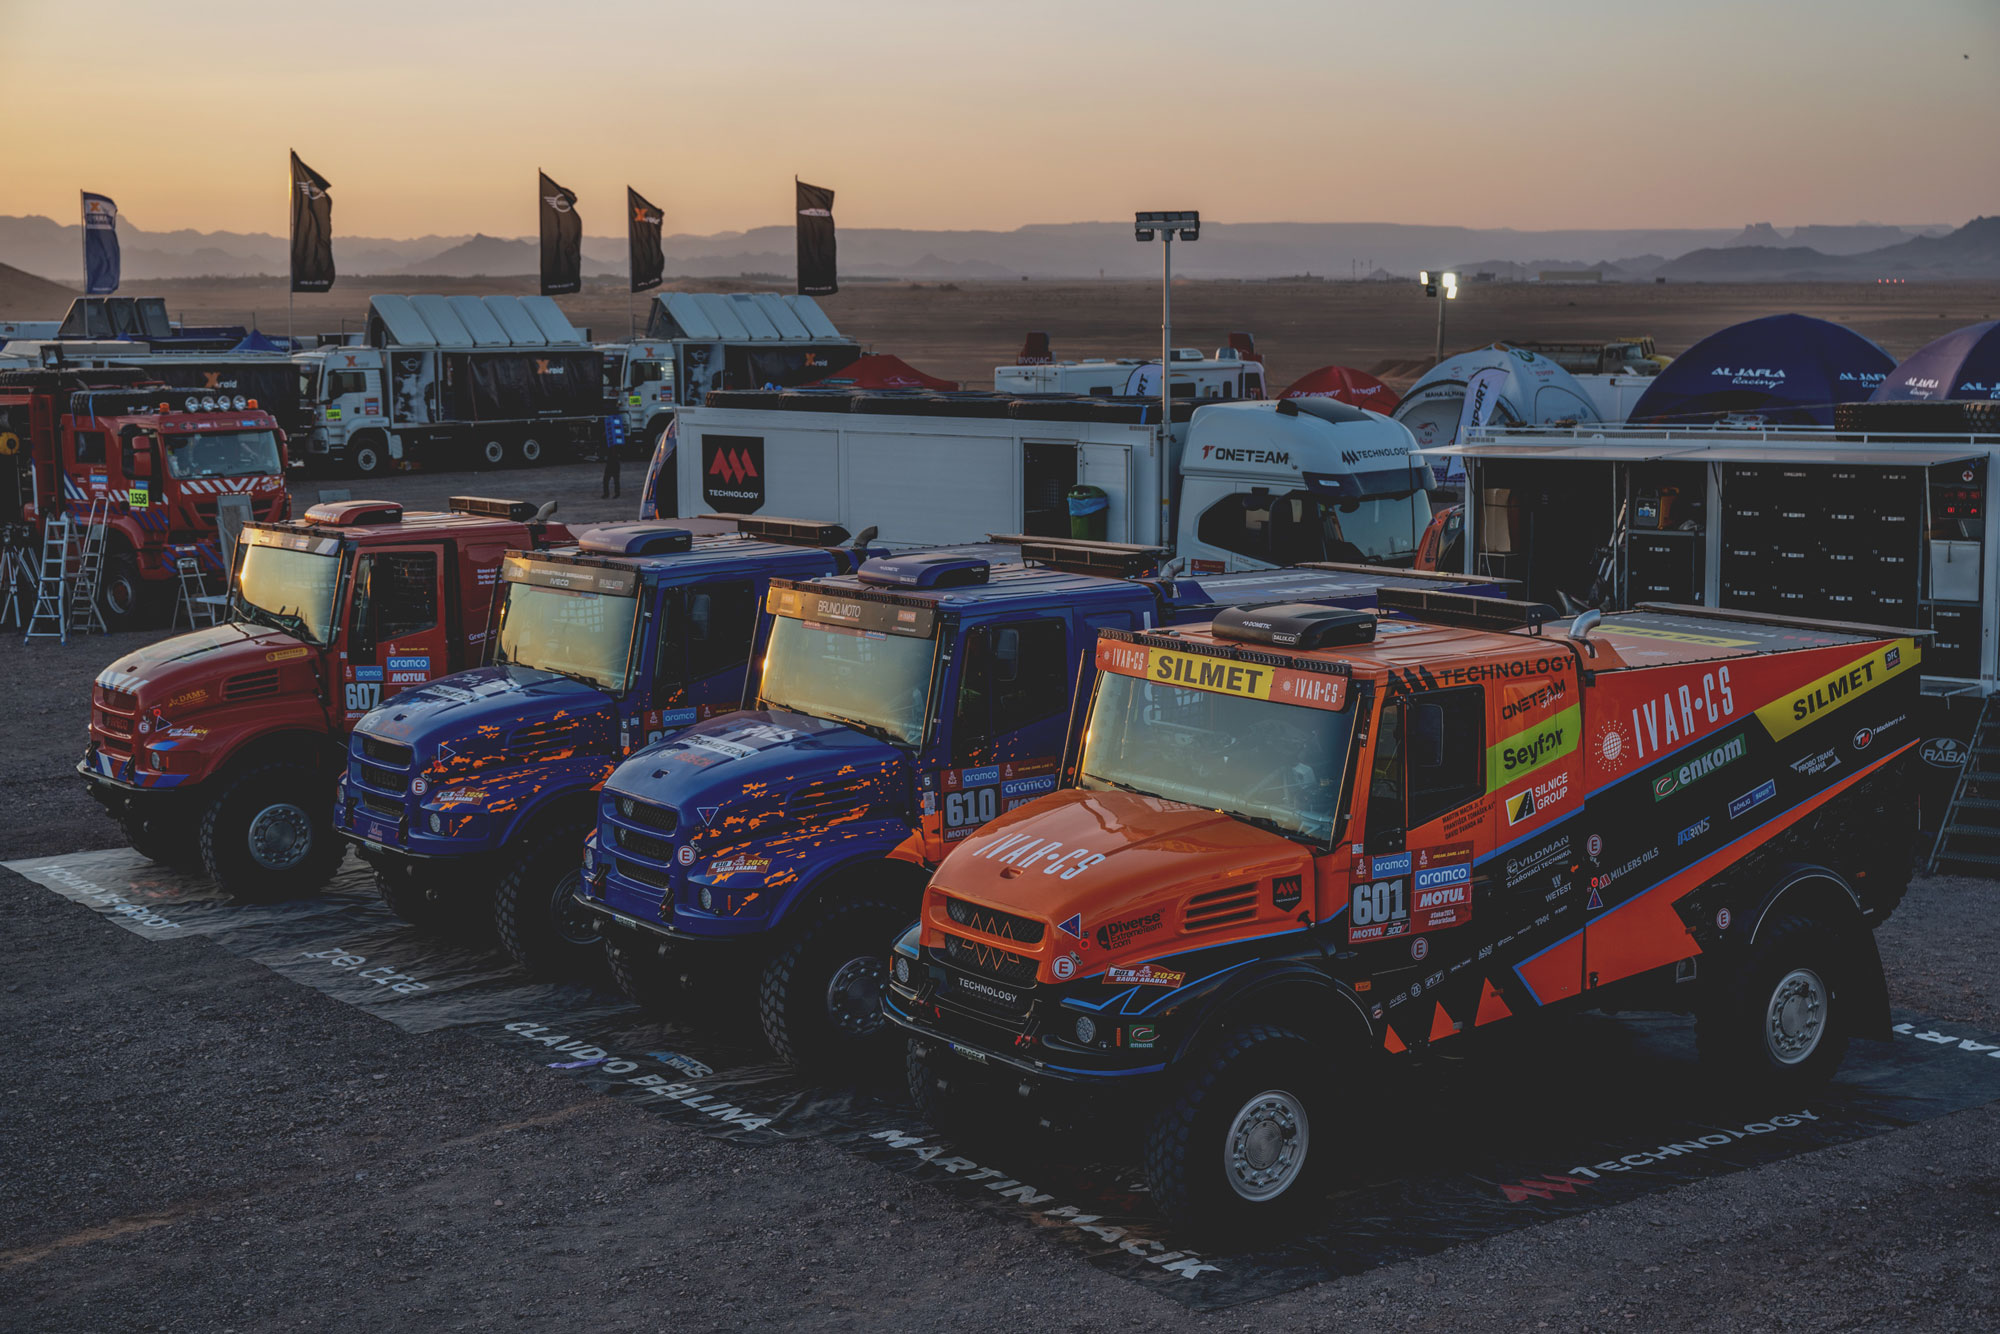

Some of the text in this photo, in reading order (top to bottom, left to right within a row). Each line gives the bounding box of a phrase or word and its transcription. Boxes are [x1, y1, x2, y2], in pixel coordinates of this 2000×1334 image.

[1711, 367, 1732, 376] AL
[1215, 448, 1289, 465] ONETEAM
[1357, 446, 1409, 459] TECHNOLOGY
[709, 489, 758, 499] TECHNOLOGY
[818, 600, 861, 616] BRUNO MOTO
[1248, 621, 1272, 630] DOMETIC
[390, 658, 427, 668] aramco
[1886, 648, 1899, 662] DFC
[357, 669, 382, 677] aramco
[391, 673, 427, 682] MOTUL
[1156, 655, 1263, 694] SILMET
[1440, 655, 1576, 686] TECHNOLOGY
[345, 683, 381, 711] 607
[1502, 680, 1566, 720] ONETEAM
[1793, 660, 1875, 721] SILMET
[664, 712, 695, 722] aramco
[1679, 737, 1743, 785] enkom
[1798, 748, 1836, 773] PROBO TRANS
[1808, 761, 1828, 775] PRAHA
[965, 771, 998, 782] aramco
[1005, 778, 1051, 794] aramco
[1535, 772, 1568, 797] SILNICE
[946, 788, 996, 827] 610
[1537, 786, 1568, 810] GROUP
[1519, 835, 1569, 867] VILDMAN
[1541, 850, 1572, 869] TECHNIKA
[746, 858, 768, 866] 2024
[1374, 860, 1409, 872] aramco
[1610, 847, 1660, 882] MILLERS OILS
[1419, 868, 1467, 886] aramco
[1353, 879, 1407, 926] 601
[1419, 887, 1464, 908] MOTUL
[1545, 882, 1573, 903] WETEST
[1108, 912, 1160, 934] Diverse
[1111, 921, 1163, 942] ExtremeTeam
[1352, 927, 1383, 940] MOTUL
[1112, 938, 1131, 950] .com
[1153, 971, 1181, 981] 2024
[958, 977, 1018, 1003] TECHNOLOGY
[627, 1073, 773, 1131] BELLINA
[1568, 1108, 1820, 1179] TECHNOLOGY
[868, 1129, 1055, 1205] MARTIN
